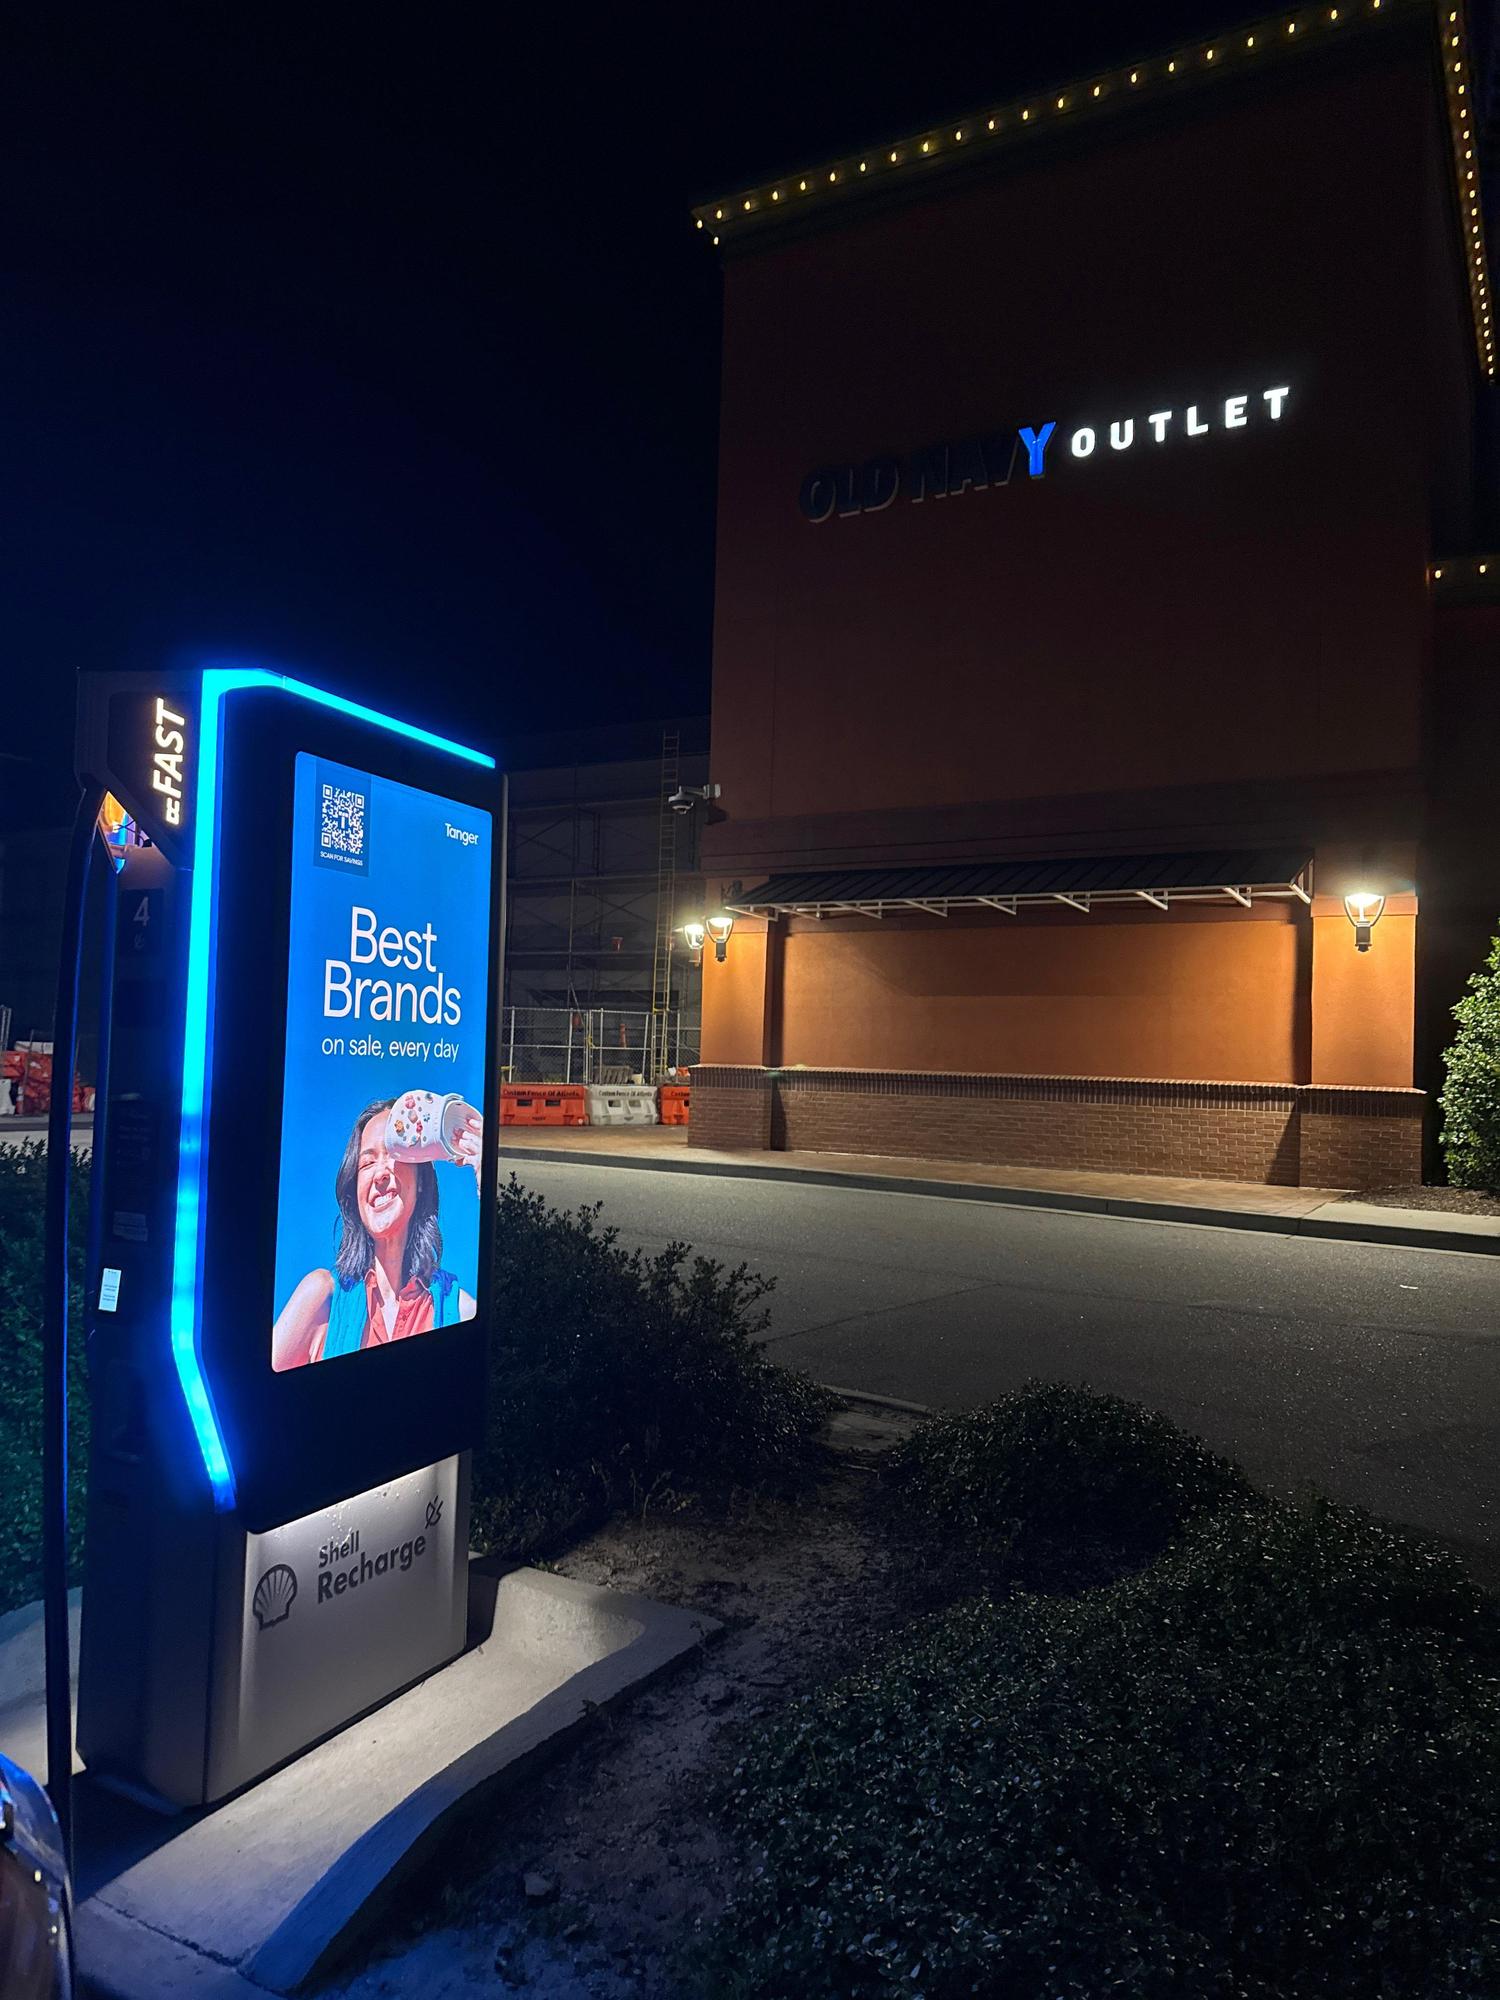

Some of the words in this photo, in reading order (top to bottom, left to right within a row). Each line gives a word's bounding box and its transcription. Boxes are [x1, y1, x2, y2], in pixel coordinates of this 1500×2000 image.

[801, 457, 899, 523] OLD
[911, 421, 1057, 504] NAVY
[1071, 387, 1289, 458] OUTLET
[153, 697, 185, 799] FAST
[320, 850, 334, 860] SCAN
[333, 853, 344, 862] FOR
[343, 856, 364, 867] SAVINGS
[444, 822, 479, 846] Tanger
[133, 895, 150, 927] 4
[350, 905, 438, 973] Best
[323, 958, 462, 1026] Brands
[321, 1037, 345, 1056] on
[348, 1033, 385, 1060] sale,
[389, 1040, 431, 1063] every
[433, 1037, 460, 1064] day
[317, 1535, 427, 1605] Recharge
[318, 1530, 360, 1569] Shell
